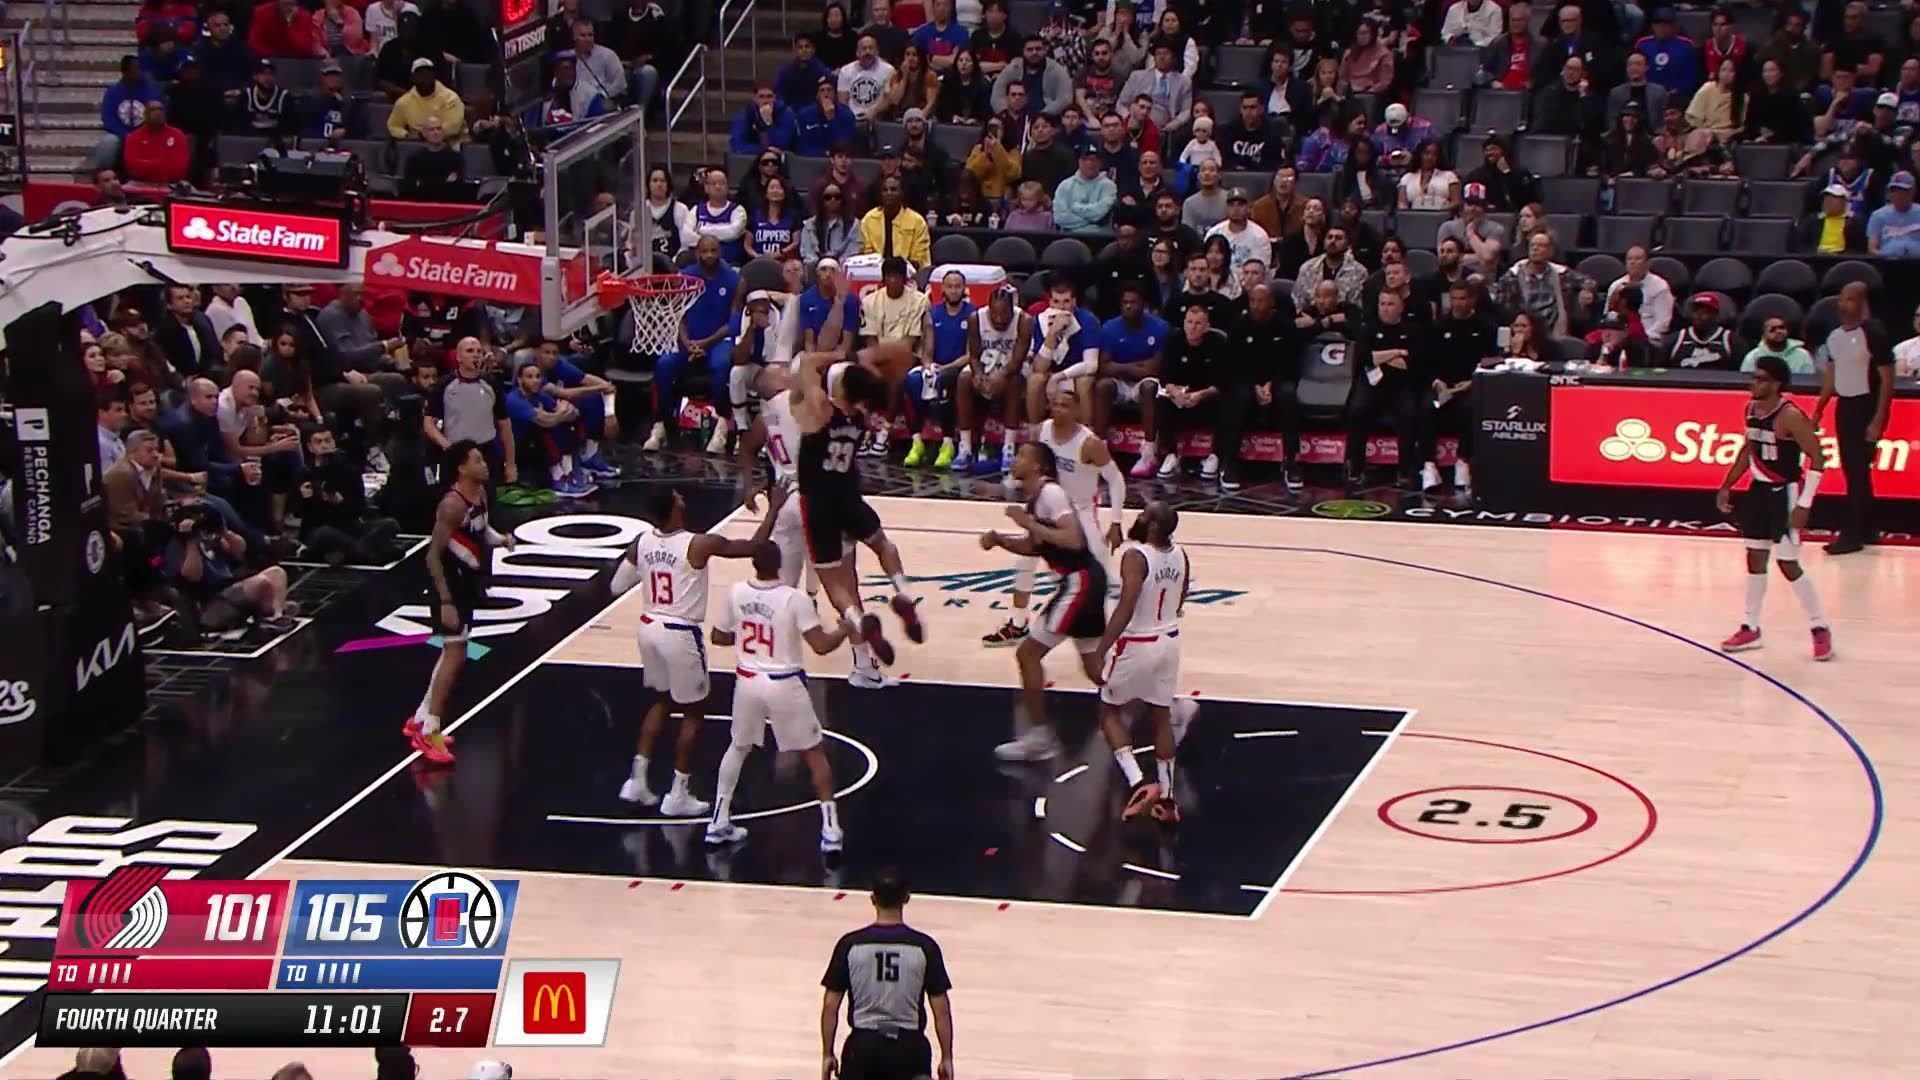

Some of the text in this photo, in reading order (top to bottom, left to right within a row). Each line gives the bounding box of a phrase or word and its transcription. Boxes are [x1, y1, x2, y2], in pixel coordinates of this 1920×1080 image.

[756, 228, 791, 243] CLIPPERS
[1481, 420, 1547, 432] STARLUX
[1492, 432, 1537, 440] AIRLINES
[822, 440, 855, 473] 33
[1670, 421, 1745, 465] Sta
[33, 446, 52, 545] PECHANGA
[1404, 506, 1739, 532] CYMBIOTIKA
[651, 571, 674, 605] 13
[1157, 587, 1167, 621] 1
[741, 620, 775, 658] 24
[1418, 799, 1552, 830] 2.5
[875, 951, 900, 982] 15
